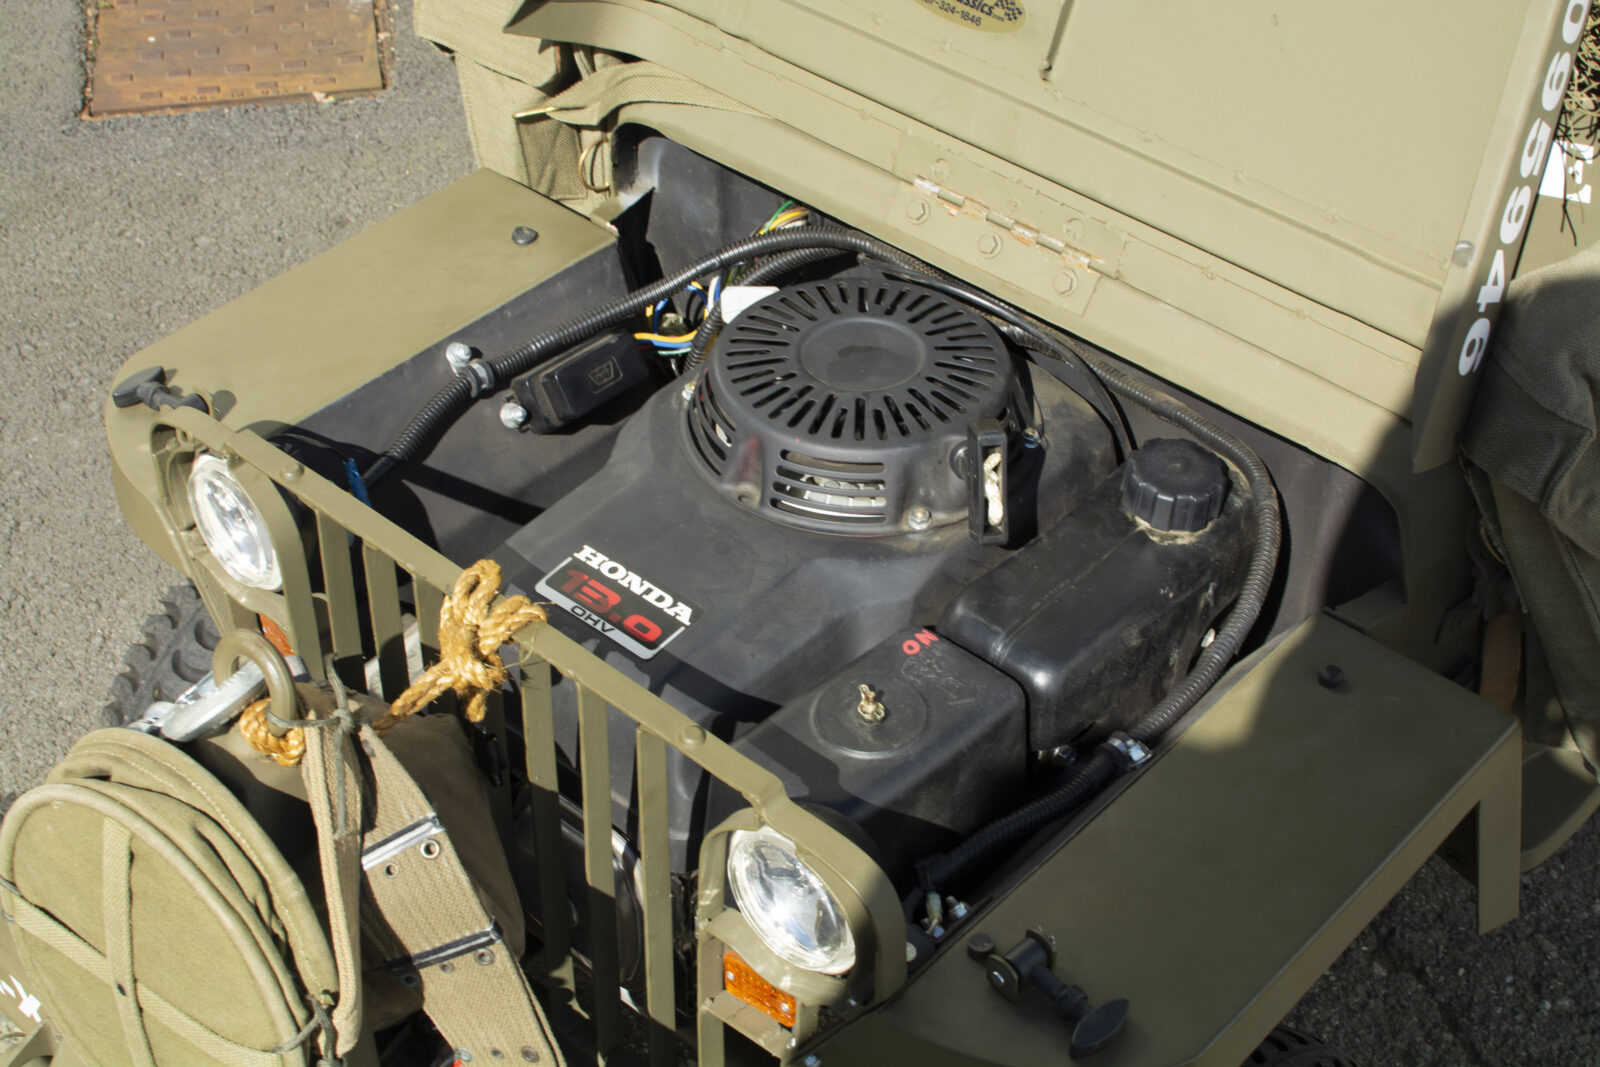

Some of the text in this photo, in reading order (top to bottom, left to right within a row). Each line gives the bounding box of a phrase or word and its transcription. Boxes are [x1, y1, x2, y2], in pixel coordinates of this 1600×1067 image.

[560, 569, 662, 643] 13.0
[573, 544, 692, 626] HONDA
[570, 605, 616, 634] OHV
[901, 629, 940, 656] ON
